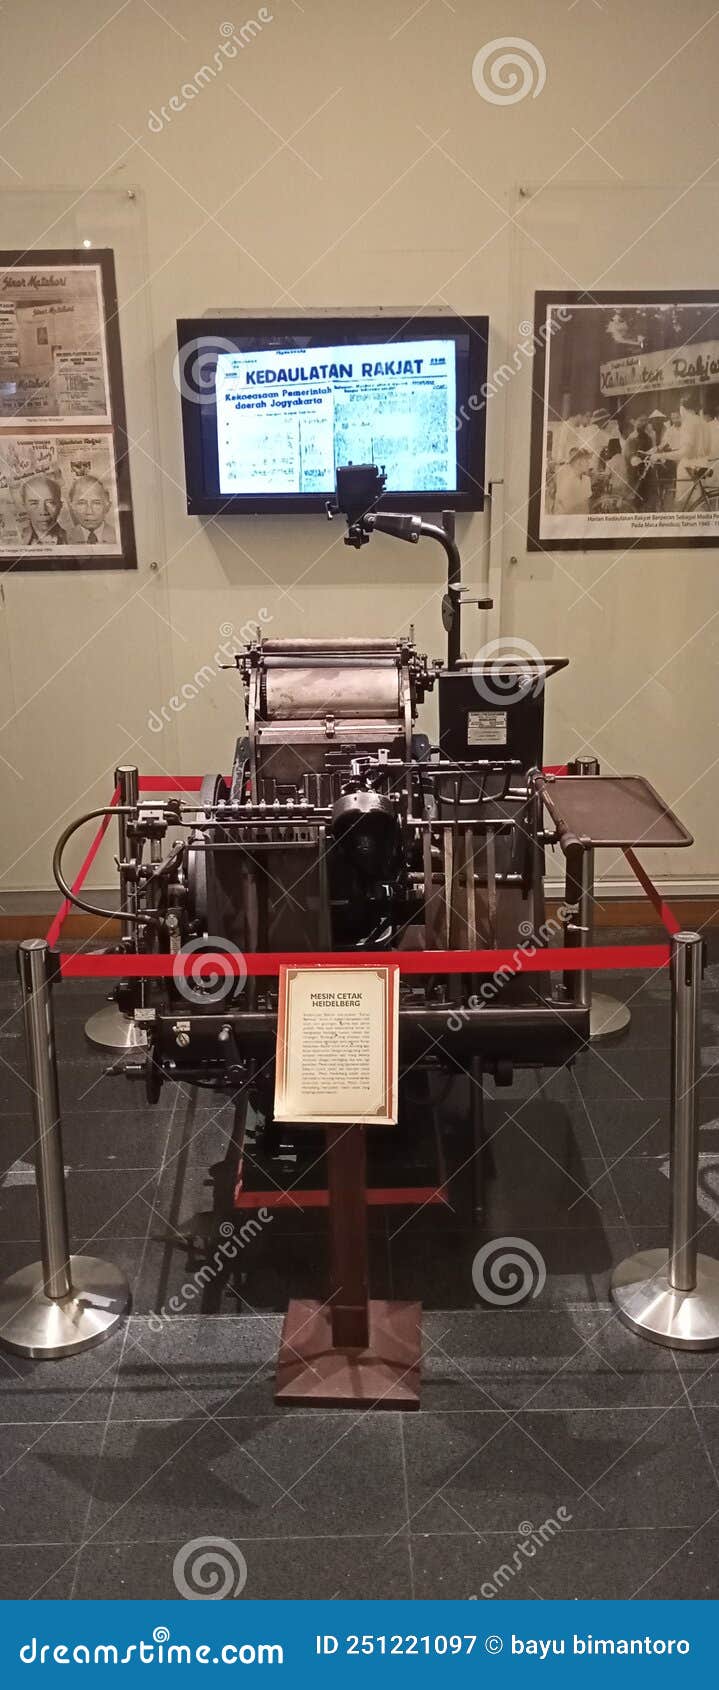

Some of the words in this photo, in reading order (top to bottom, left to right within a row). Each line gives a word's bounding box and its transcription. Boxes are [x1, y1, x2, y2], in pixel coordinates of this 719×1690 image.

[246, 363, 353, 386] KEDAULATAN
[361, 359, 424, 378] RAKJAT
[337, 992, 363, 1000] CETAK
